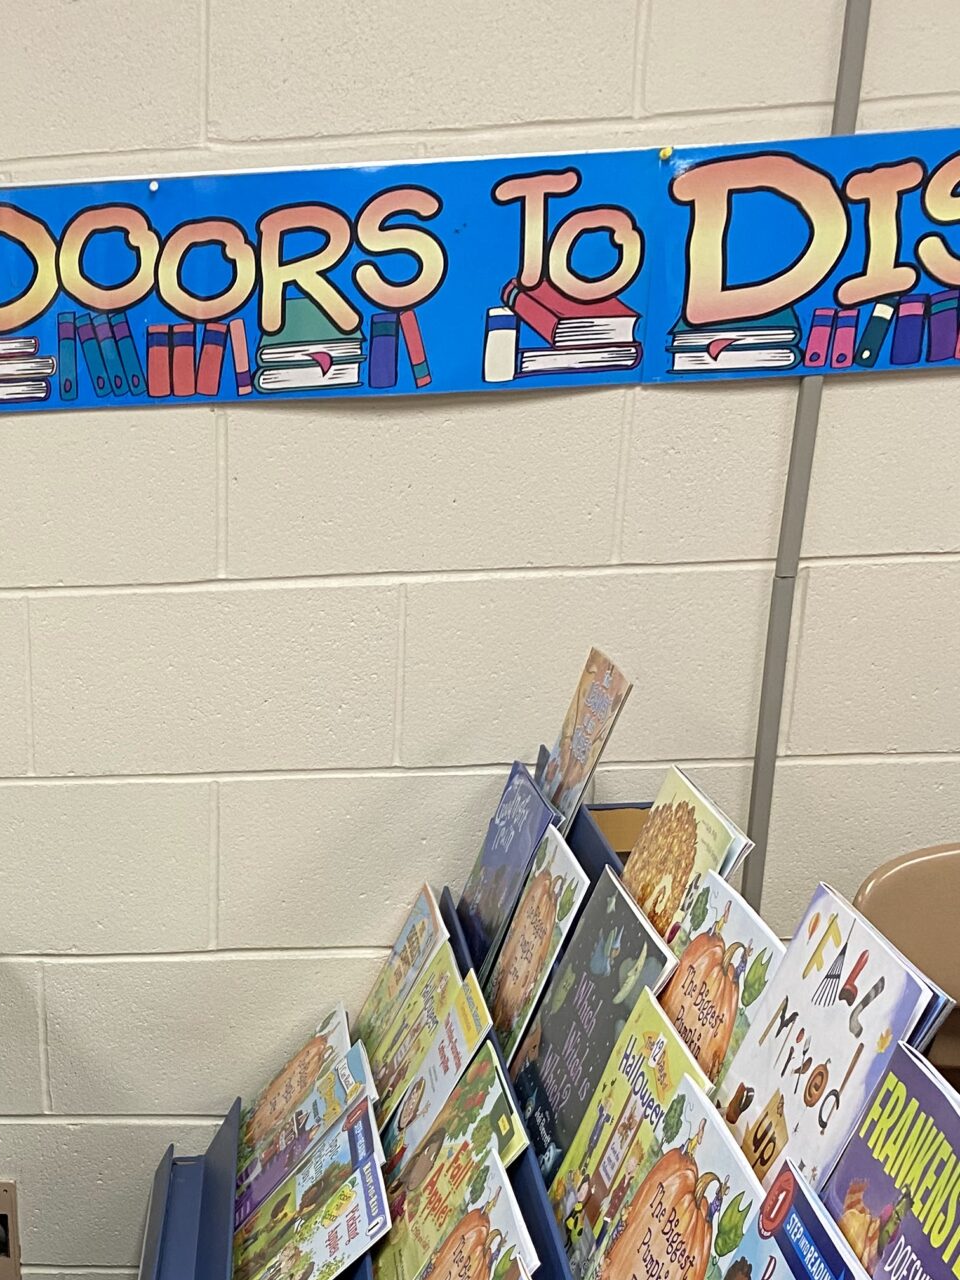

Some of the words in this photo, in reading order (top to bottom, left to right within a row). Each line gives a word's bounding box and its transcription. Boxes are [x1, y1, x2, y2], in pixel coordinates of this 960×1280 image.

[573, 972, 603, 1038] Which
[680, 964, 698, 997] The
[693, 981, 725, 1038] Biggest
[803, 912, 885, 1039] FALL
[562, 1021, 590, 1086] Witch
[675, 1006, 701, 1060] Pumpkin
[419, 1163, 452, 1228] Apples
[446, 1140, 475, 1193] Fall
[859, 1071, 960, 1280] FRANKENS
[649, 1182, 667, 1224] The
[770, 1190, 786, 1219] 1
[785, 1213, 802, 1242] STEP
[453, 1234, 466, 1265] The
